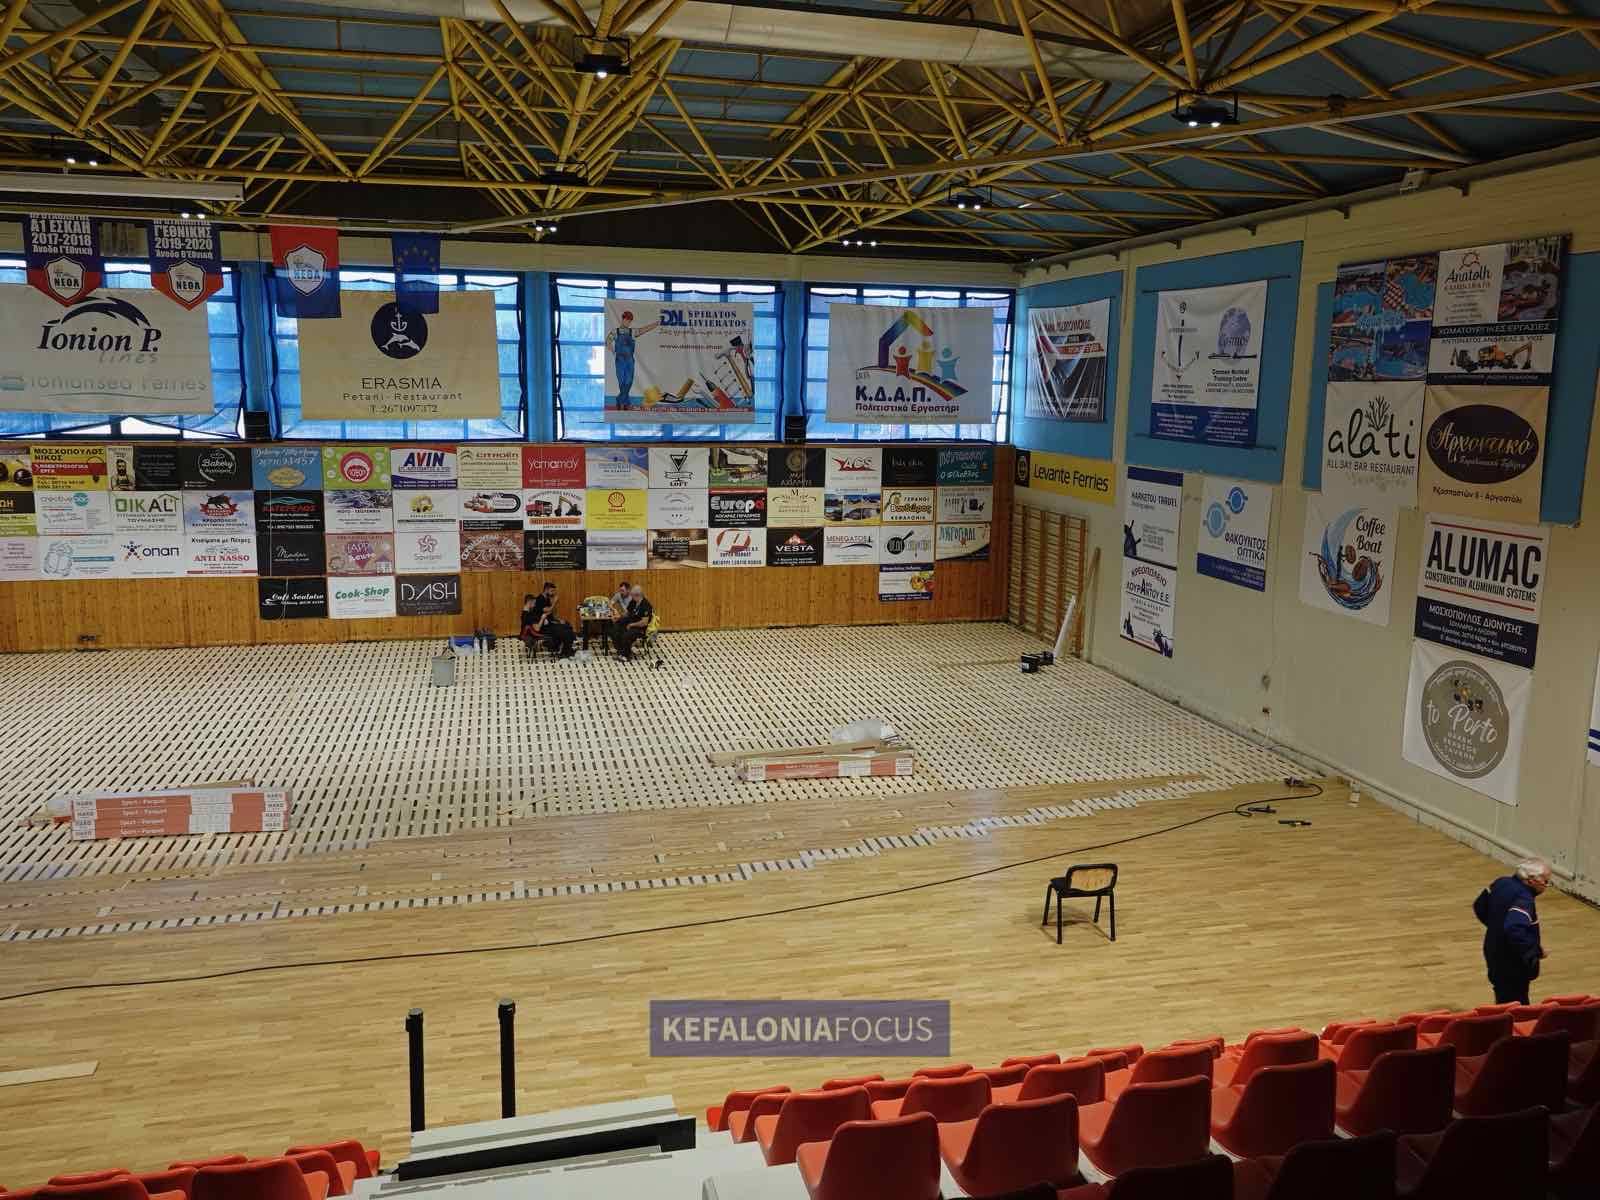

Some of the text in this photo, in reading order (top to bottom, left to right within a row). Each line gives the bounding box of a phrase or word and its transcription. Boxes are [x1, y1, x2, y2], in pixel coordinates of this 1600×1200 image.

[32, 232, 92, 247] 2017-2018
[154, 237, 213, 251] 2019-2020
[362, 377, 442, 391] ERASMIA
[855, 385, 932, 403] Κ.Δ.Α.Π.
[403, 452, 445, 467] AVIN
[1033, 463, 1109, 493] Levante Ferries
[1355, 515, 1386, 538] Coffee
[1356, 534, 1383, 555] Boat
[1426, 529, 1541, 590] ALUMAC
[335, 587, 390, 600] Cook-Shop
[401, 582, 457, 601] DASH
[1424, 570, 1538, 605] CONSTRUCTION ALUMINIUM SYSTEMS
[1447, 703, 1497, 744] Porto
